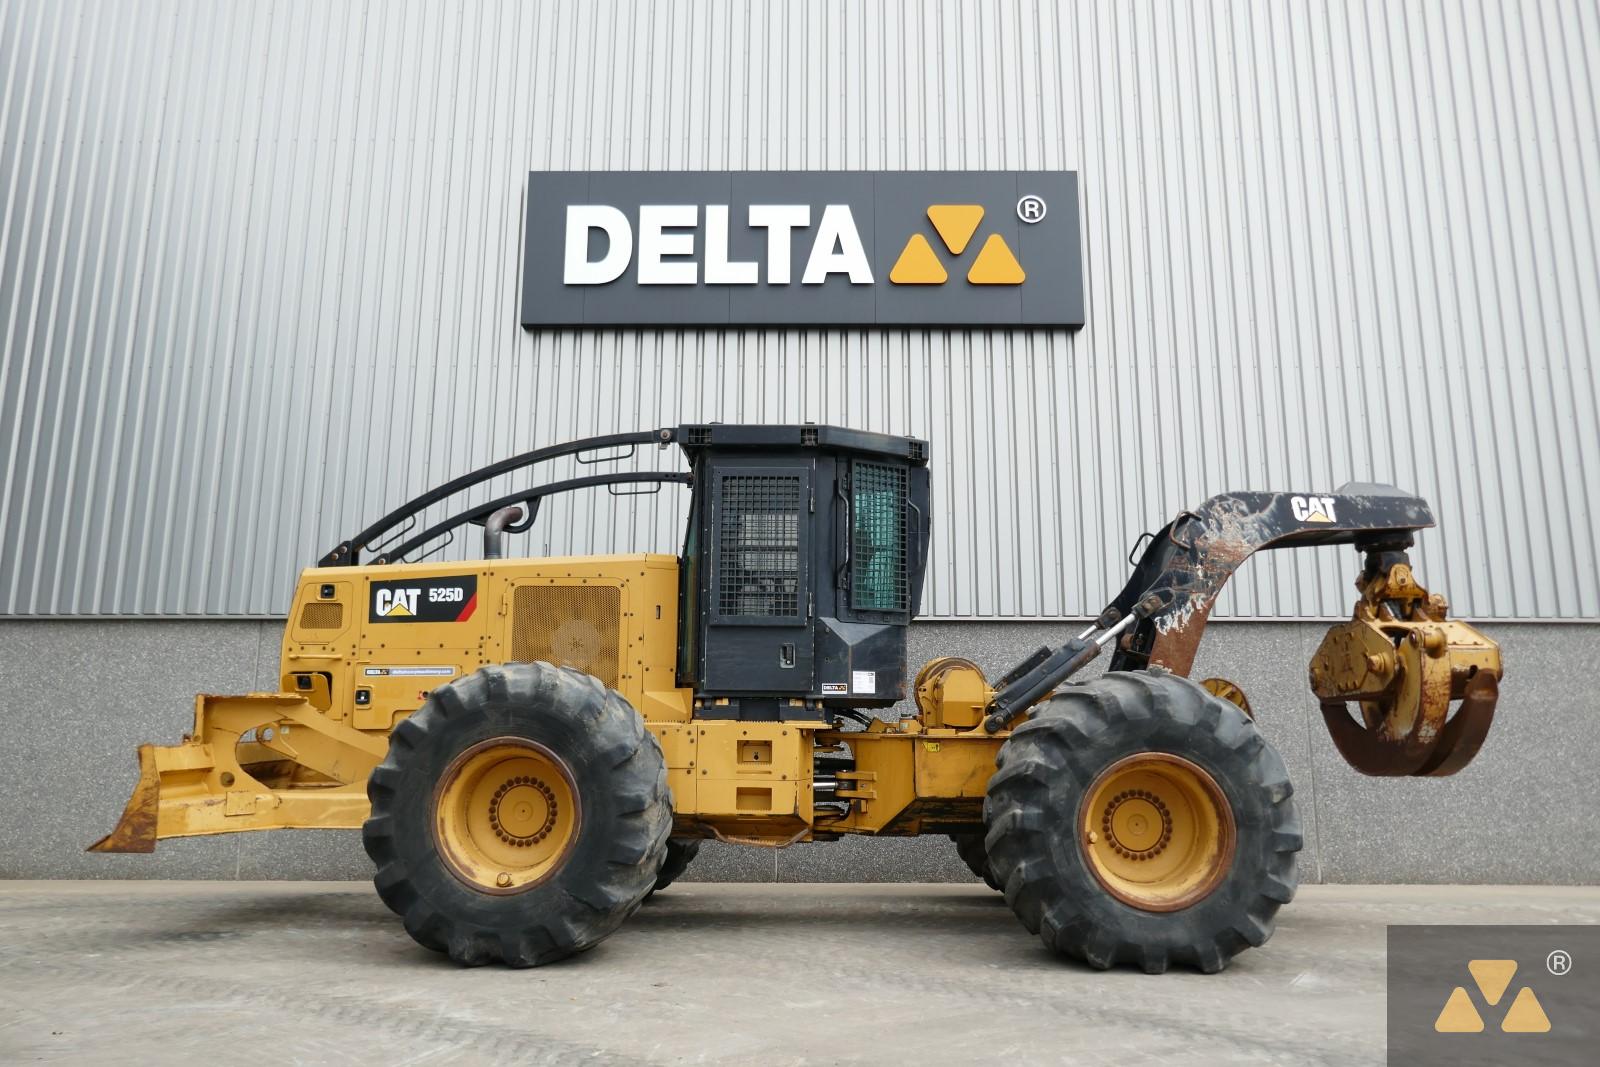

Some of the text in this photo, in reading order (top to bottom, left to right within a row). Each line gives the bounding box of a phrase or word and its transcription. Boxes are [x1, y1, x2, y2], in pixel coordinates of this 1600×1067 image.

[563, 205, 875, 284] DELTA
[1290, 496, 1337, 523] CAT
[376, 587, 464, 616] CAT 525D
